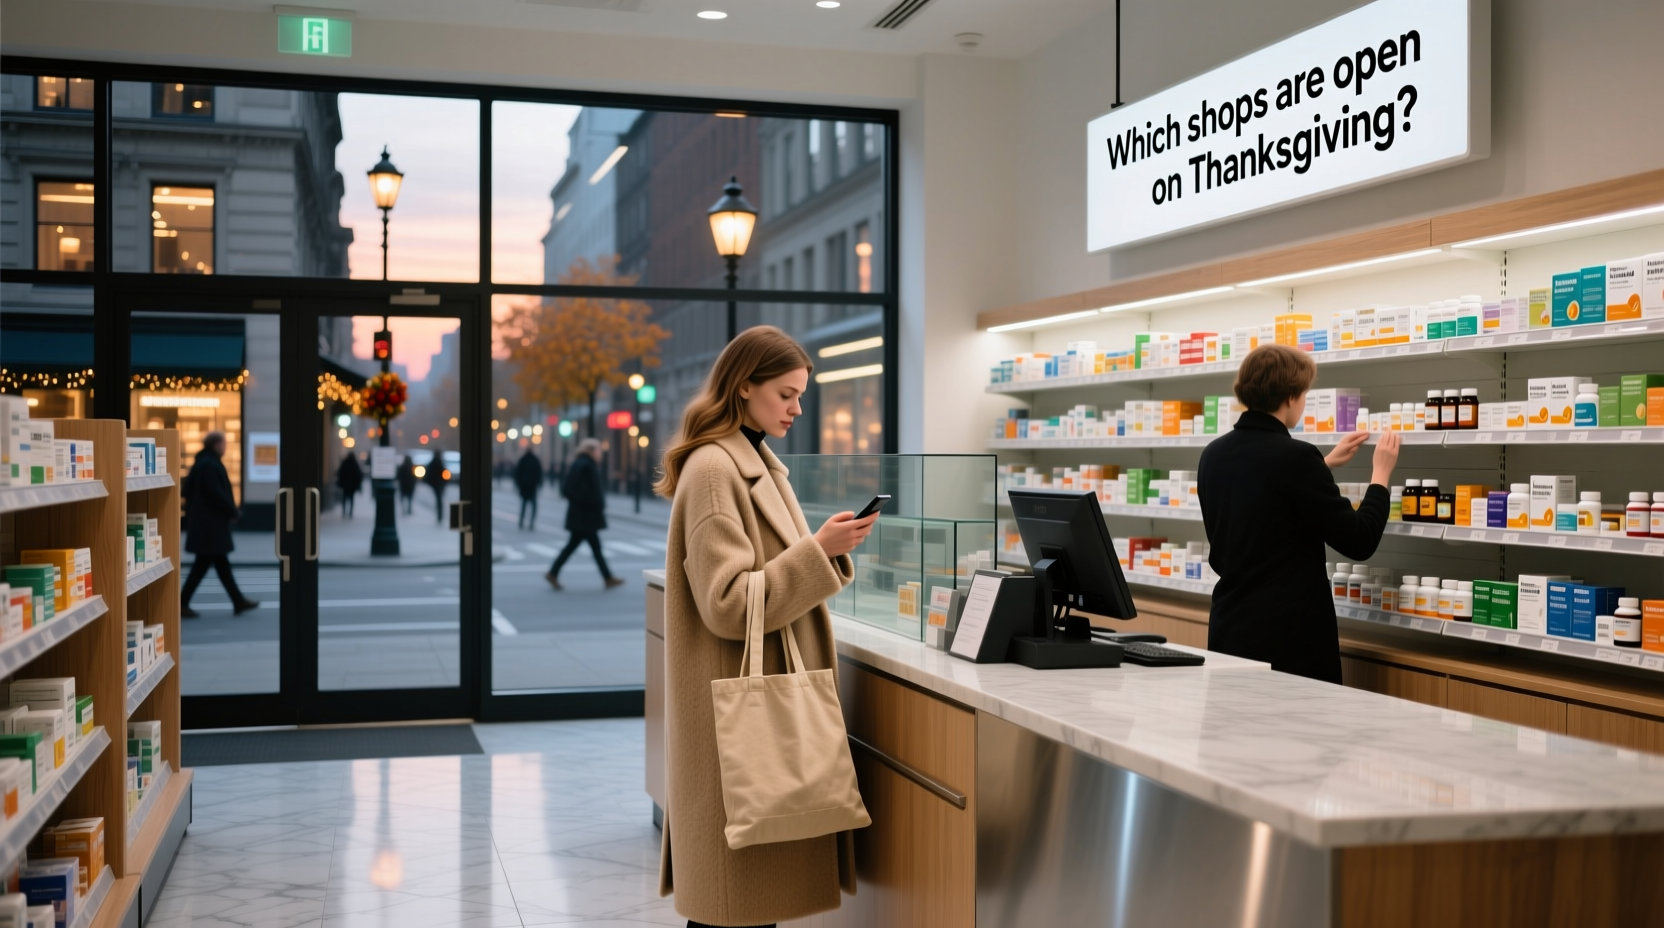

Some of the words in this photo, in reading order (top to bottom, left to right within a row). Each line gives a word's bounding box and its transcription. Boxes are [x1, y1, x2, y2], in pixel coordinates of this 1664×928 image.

[1106, 114, 1181, 170] Which
[1187, 88, 1269, 143] shops
[1275, 67, 1325, 111] are
[1333, 29, 1421, 97] open
[1151, 172, 1182, 206] on
[1188, 84, 1418, 194] Thanksgiving?
